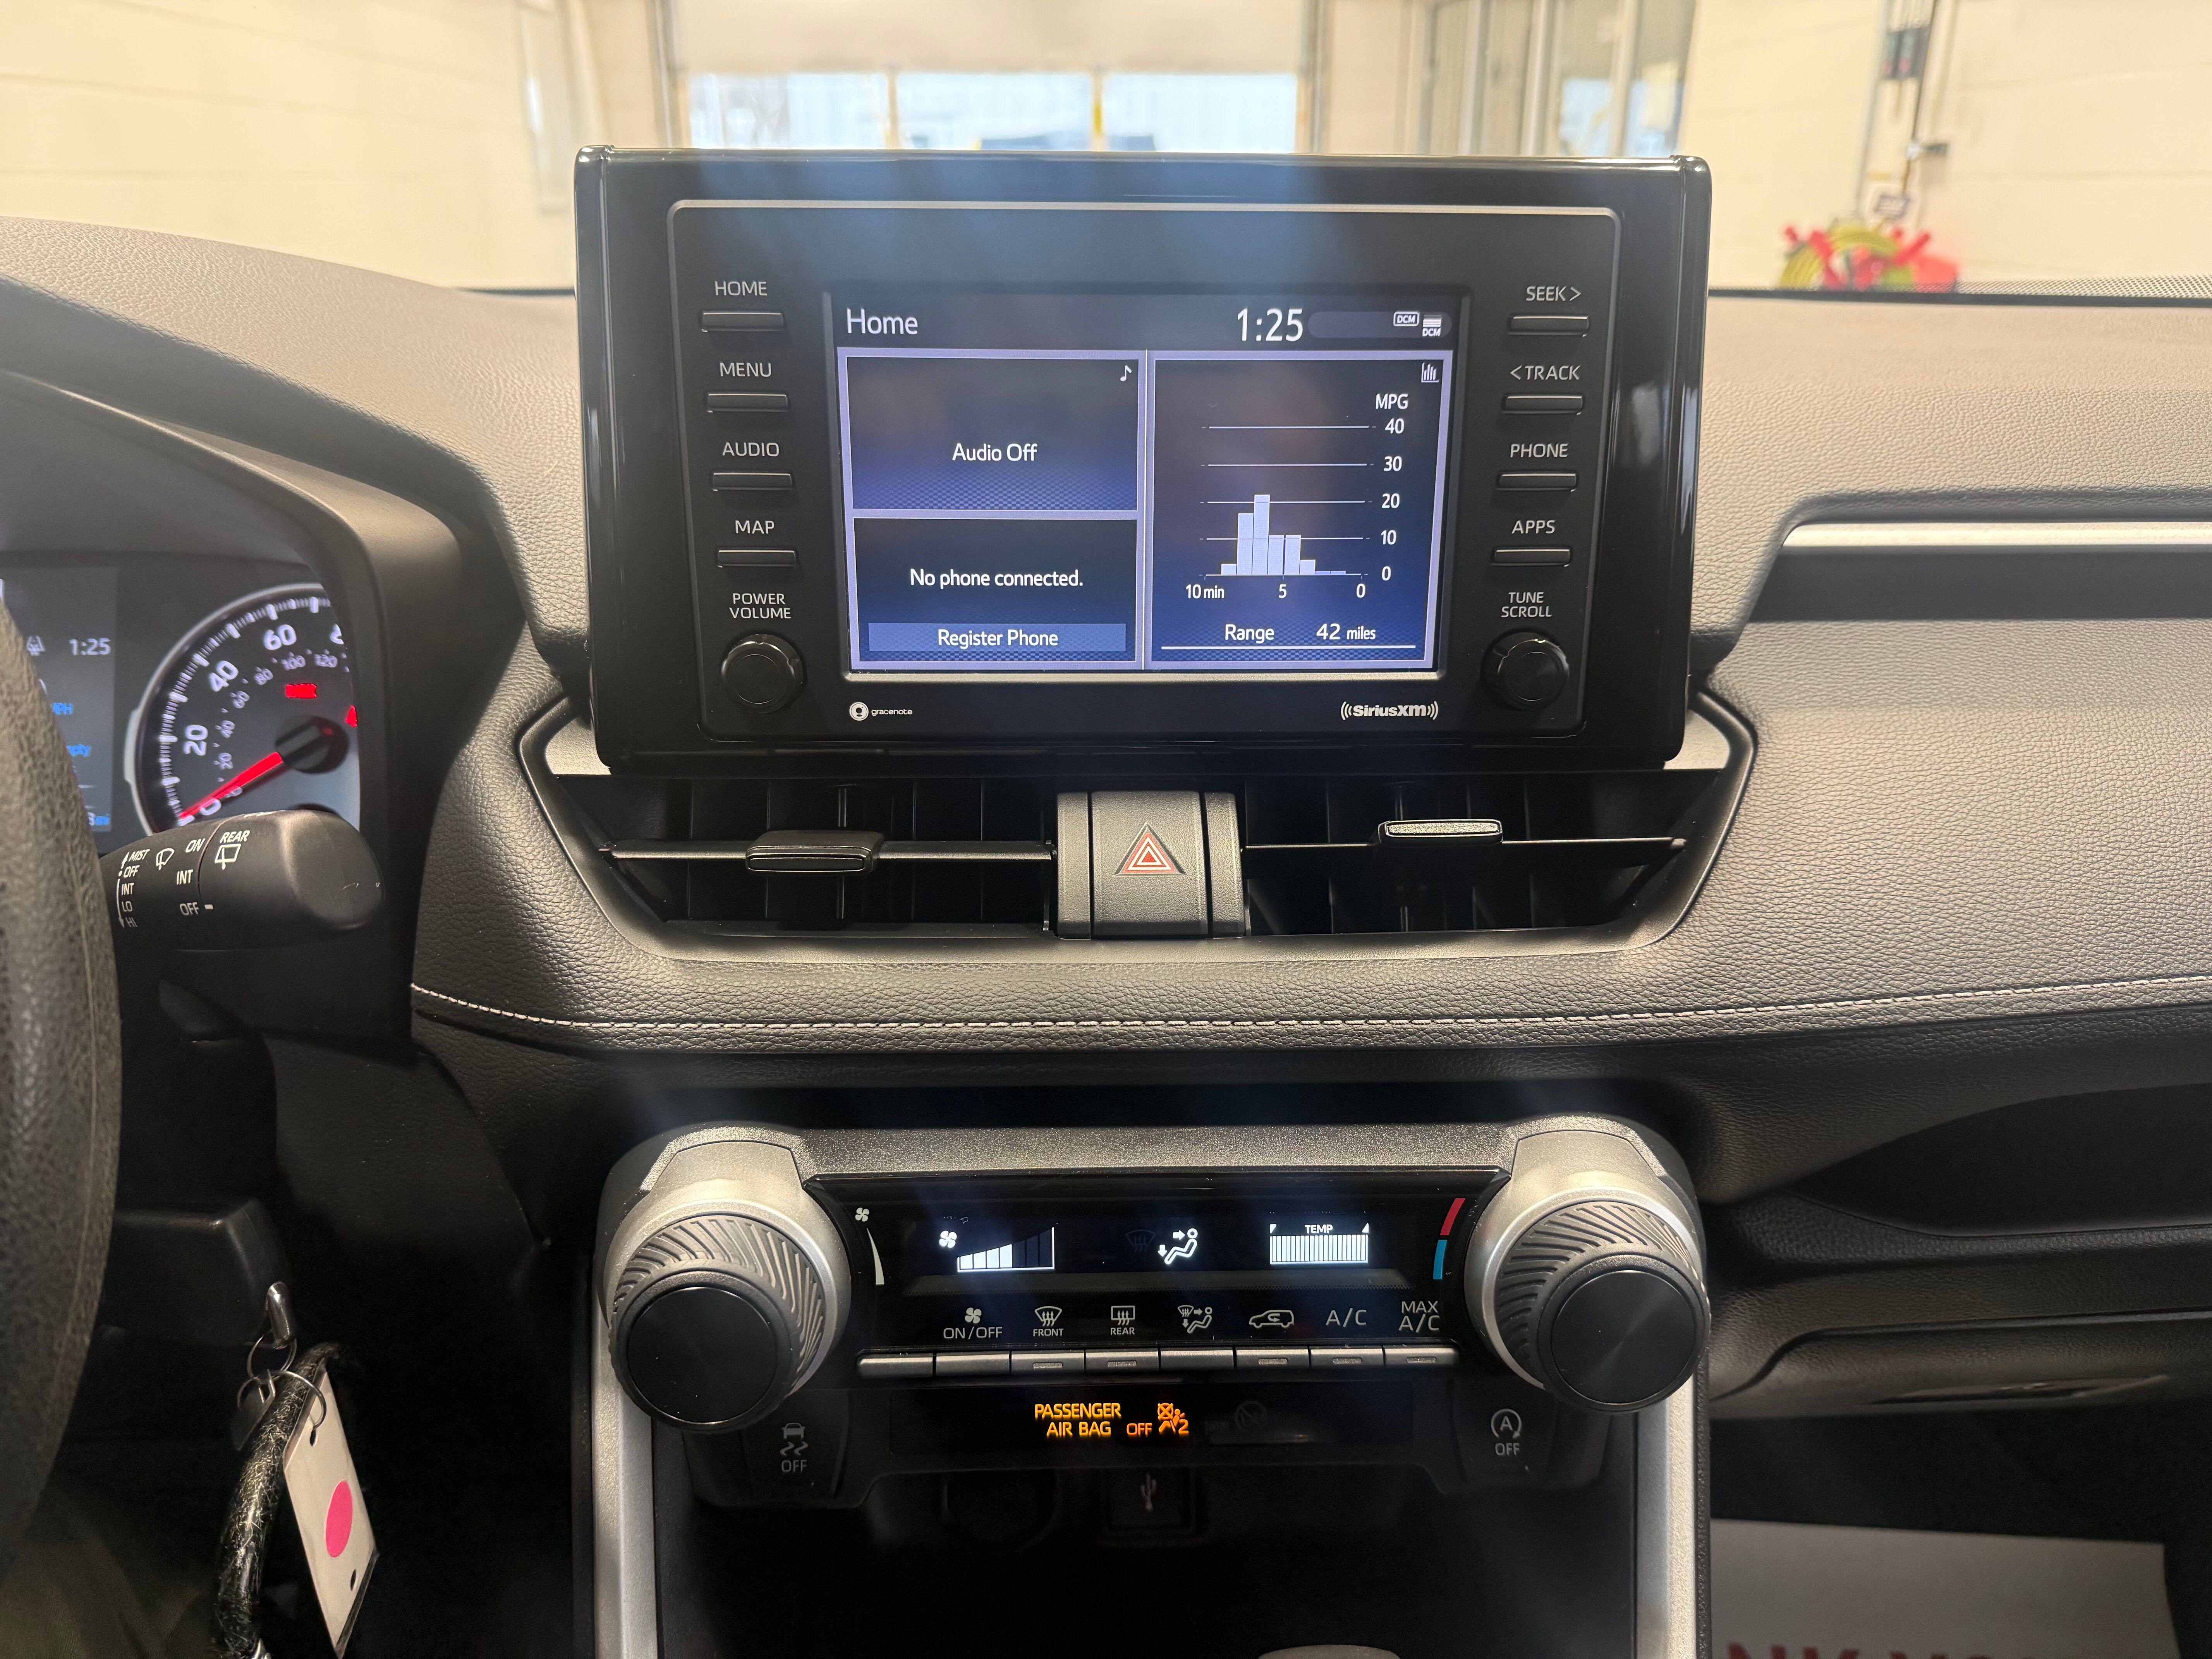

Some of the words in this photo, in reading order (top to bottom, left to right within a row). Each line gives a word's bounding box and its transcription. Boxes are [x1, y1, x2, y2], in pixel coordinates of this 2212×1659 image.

[715, 281, 768, 296] HOME
[847, 308, 918, 335] Home
[1237, 308, 1303, 342] 1:25
[1396, 314, 1416, 324] DCM
[1422, 327, 1441, 337] DCM
[720, 362, 771, 377] MENU
[1376, 393, 1408, 409] MPG
[1385, 418, 1404, 434] 40
[722, 442, 779, 457] AUDIO
[952, 443, 1002, 461] Audio
[1006, 443, 1038, 462] Off
[1510, 443, 1568, 458] PHONE
[1383, 456, 1402, 472] 30
[1381, 493, 1400, 508] 20
[735, 520, 775, 534] MAP
[1511, 520, 1555, 534] APPS
[1381, 530, 1396, 545] 10
[910, 568, 935, 586] No
[940, 568, 990, 589] phone
[994, 569, 1083, 586] connected.
[1382, 566, 1391, 581] 0
[1186, 584, 1201, 599] 10
[1204, 585, 1224, 599] min
[1278, 584, 1287, 598] 5
[1356, 583, 1365, 598] 0
[1508, 592, 1544, 603] TUNE
[733, 593, 786, 605] POWER
[729, 607, 791, 619] VOLUME
[1501, 606, 1552, 618] SCROLL
[264, 624, 297, 650] 60
[938, 629, 1003, 649] Register
[1007, 630, 1059, 646] Phone
[1224, 624, 1275, 644] Range
[1316, 623, 1341, 640] 42
[1346, 626, 1376, 640] miles
[70, 638, 110, 655] 1:25
[281, 655, 306, 670] 100
[314, 654, 337, 668] 120
[209, 660, 239, 692] 40
[184, 725, 208, 756] 20
[200, 798, 222, 816] 0
[220, 830, 250, 843] REAR
[185, 838, 205, 853] ON
[128, 849, 150, 862] MIST
[123, 865, 140, 878] OFF
[176, 869, 194, 885] INT
[121, 883, 134, 895] INT
[122, 901, 133, 912] LO
[179, 902, 199, 915] OFF
[125, 917, 138, 928] HI
[1305, 1224, 1333, 1233] TEMP
[1401, 1300, 1438, 1313] MAX
[1326, 1308, 1367, 1327] A/C
[1398, 1315, 1440, 1333] A/C
[1033, 1328, 1064, 1336] FRONT
[1110, 1327, 1135, 1335] REAR
[1035, 1403, 1121, 1419] PASSENGER
[1046, 1422, 1073, 1437] AIR
[1079, 1421, 1111, 1436] BAG
[1126, 1422, 1152, 1436] OFF
[1495, 1443, 1520, 1456] OFF
[781, 1459, 807, 1472] OFF
